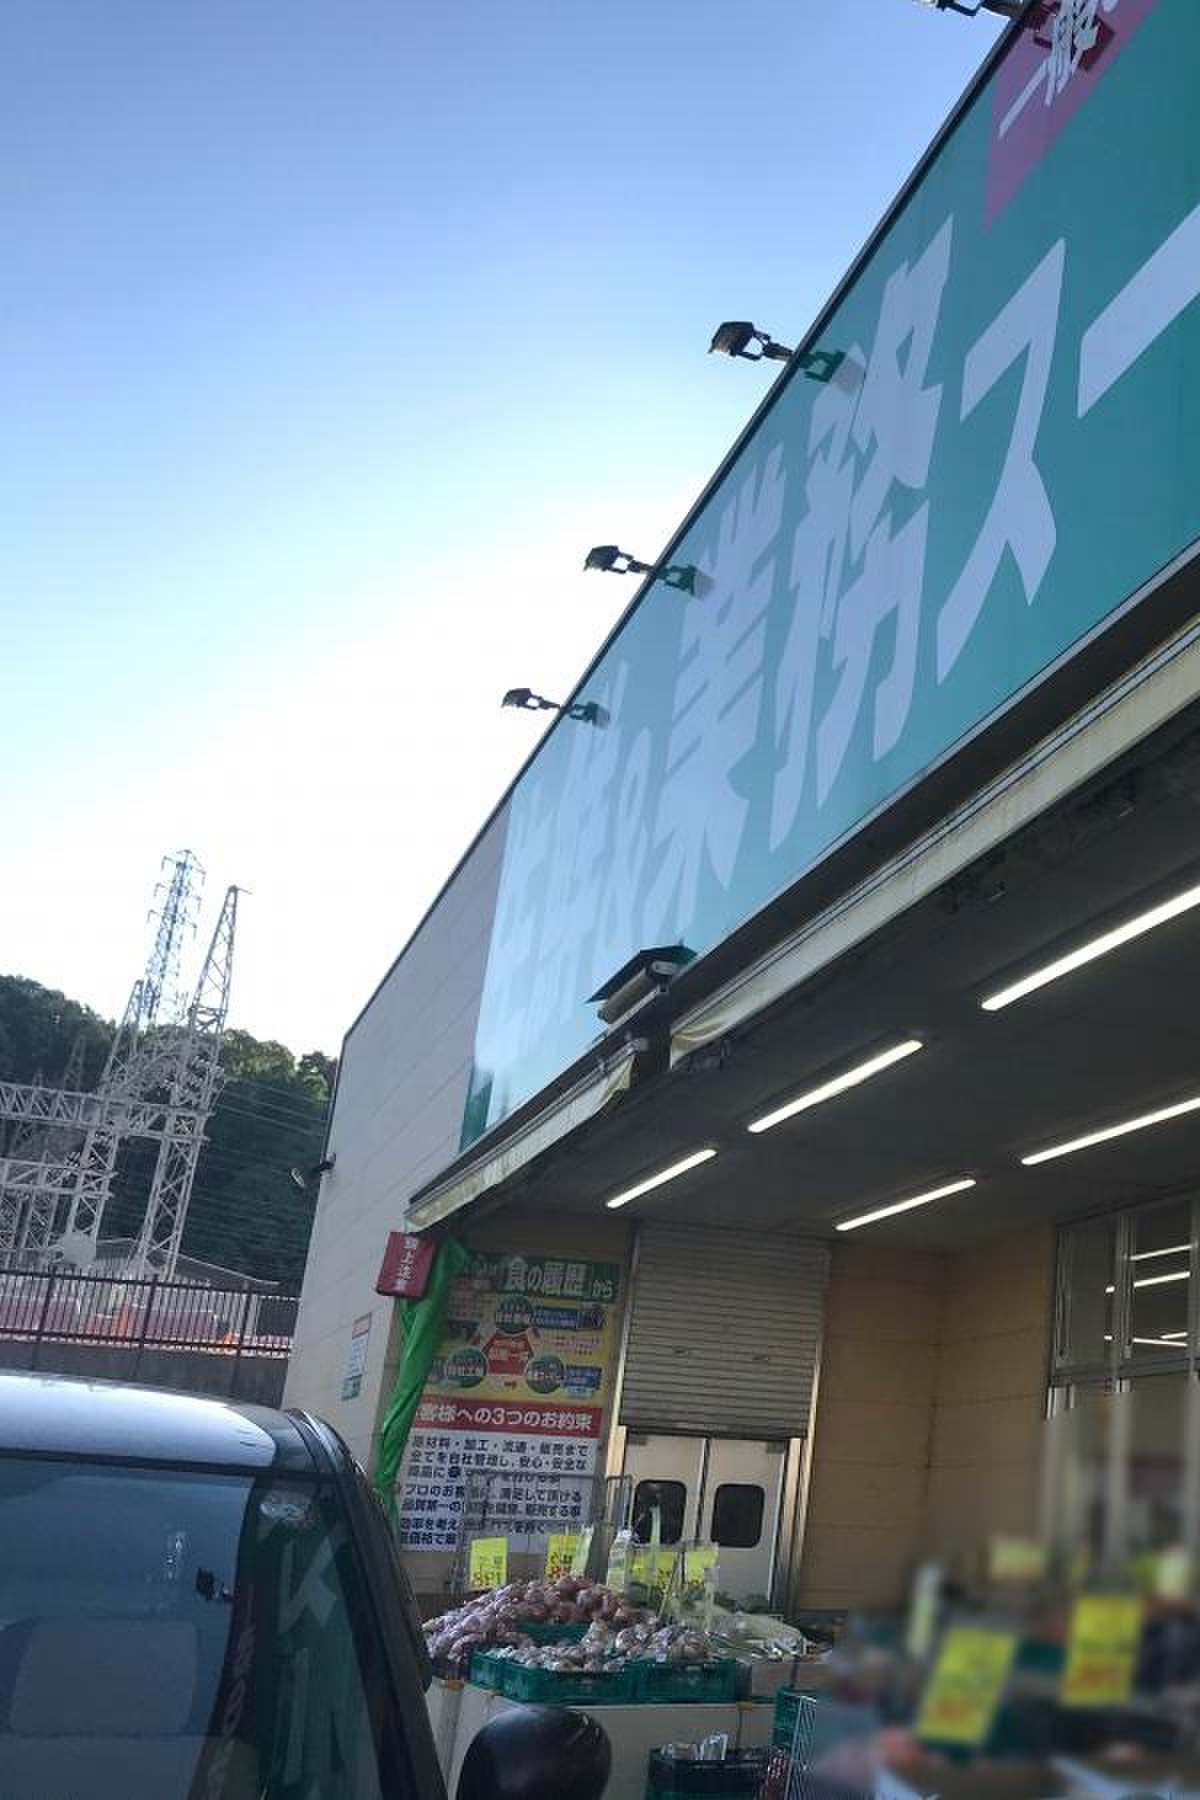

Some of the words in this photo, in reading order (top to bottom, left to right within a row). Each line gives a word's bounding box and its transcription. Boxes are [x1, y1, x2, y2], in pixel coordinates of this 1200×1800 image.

[415, 1404, 593, 1431] 客様への3つのお約束
